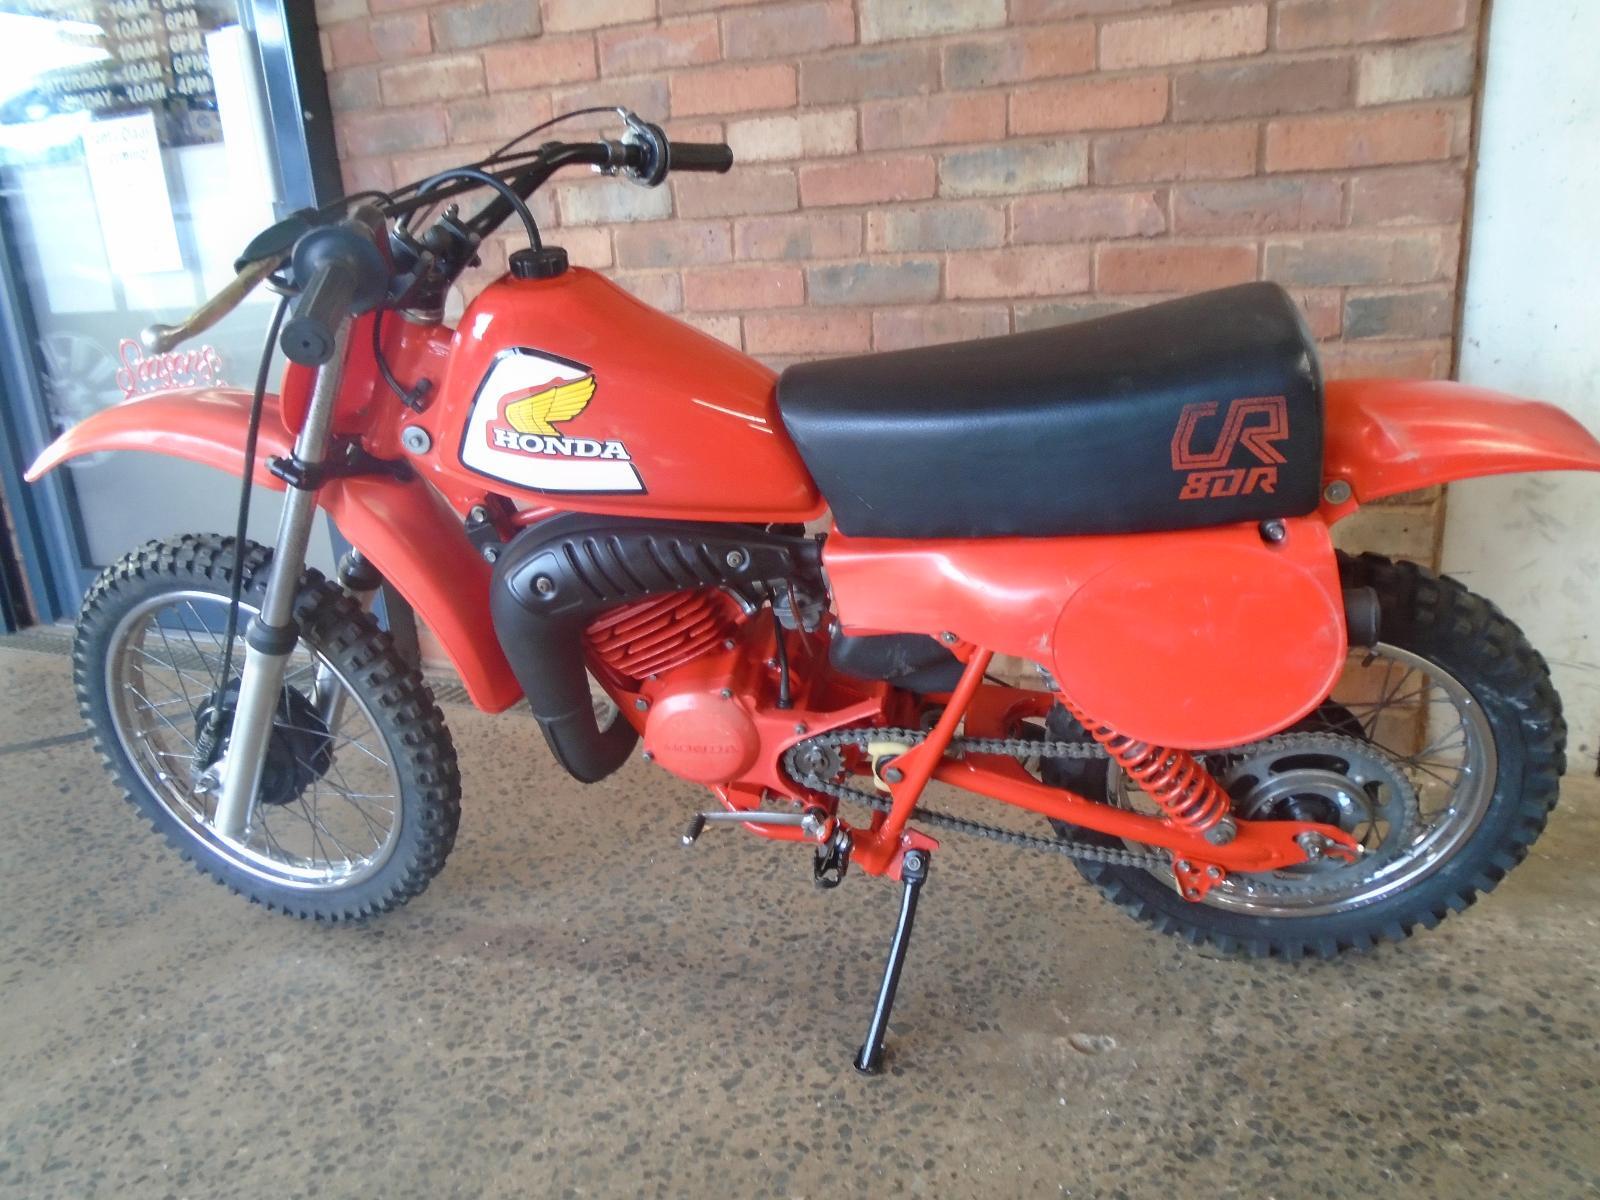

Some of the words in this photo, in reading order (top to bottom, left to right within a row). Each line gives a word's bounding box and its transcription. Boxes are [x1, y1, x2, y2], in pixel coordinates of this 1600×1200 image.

[114, 19, 154, 40] 10AM
[165, 9, 199, 32] 6PM
[118, 40, 159, 61] 10AM
[169, 31, 202, 53] 6PM
[122, 61, 163, 82] 10AM
[173, 54, 206, 75] 6PM
[126, 81, 167, 104] 10AM
[178, 75, 212, 95] 4PM
[493, 428, 631, 460] HONDA
[1170, 395, 1289, 470] CR
[1178, 466, 1278, 500] 80R
